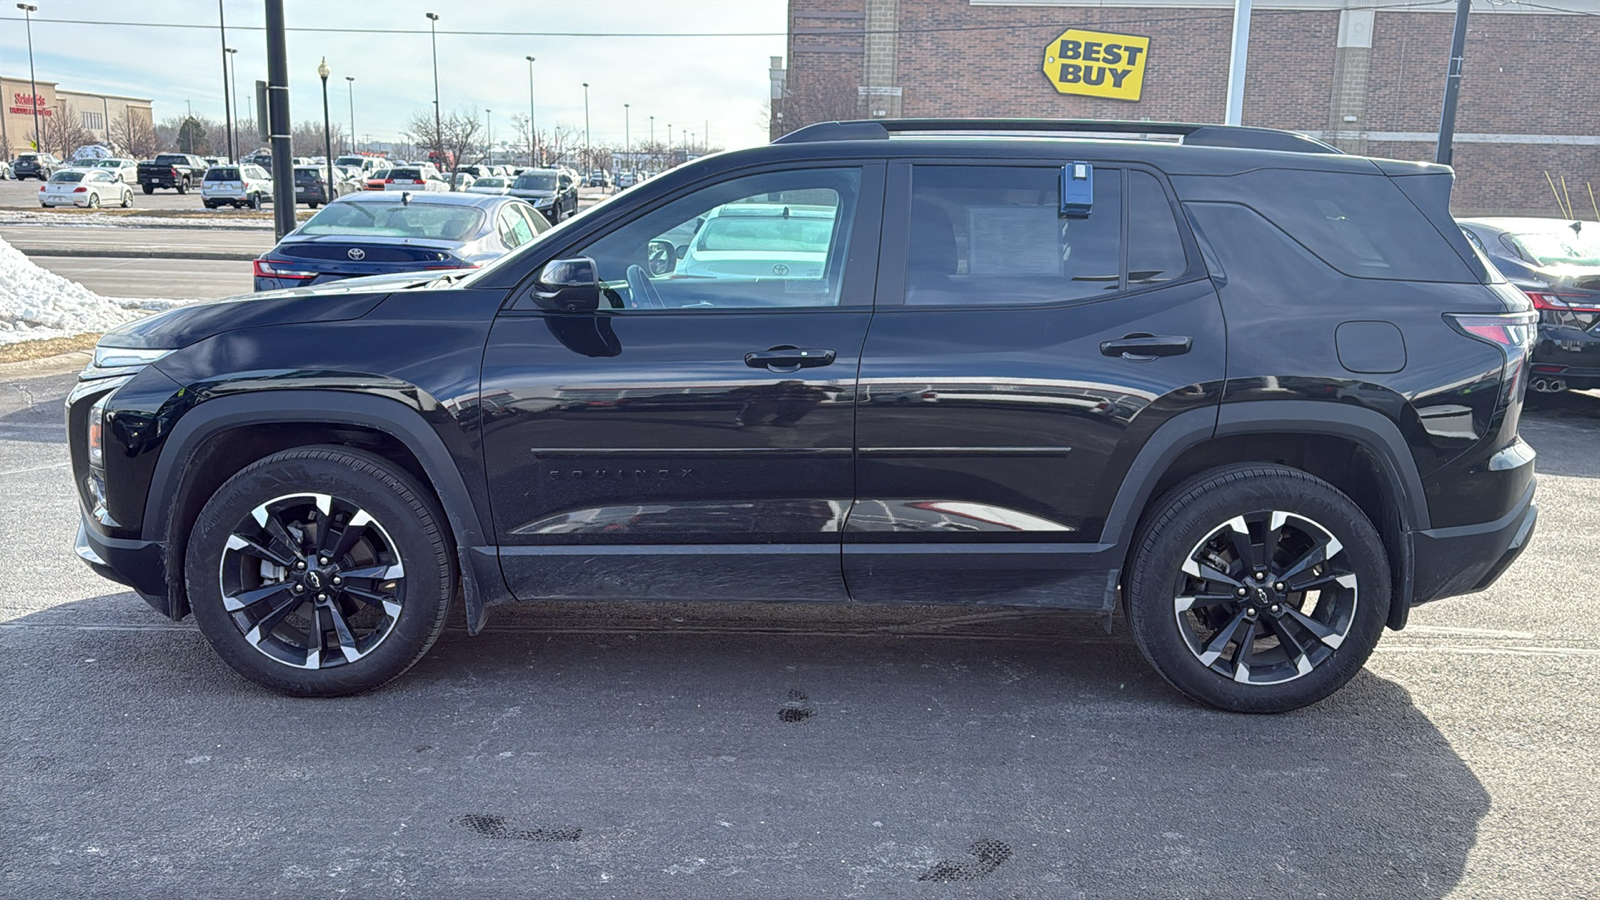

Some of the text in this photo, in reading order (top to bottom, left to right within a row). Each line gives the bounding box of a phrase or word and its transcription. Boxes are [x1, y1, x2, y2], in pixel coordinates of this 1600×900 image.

[1058, 39, 1144, 67] BEST
[1058, 63, 1133, 89] BUY
[549, 468, 693, 481] EQUINOX
